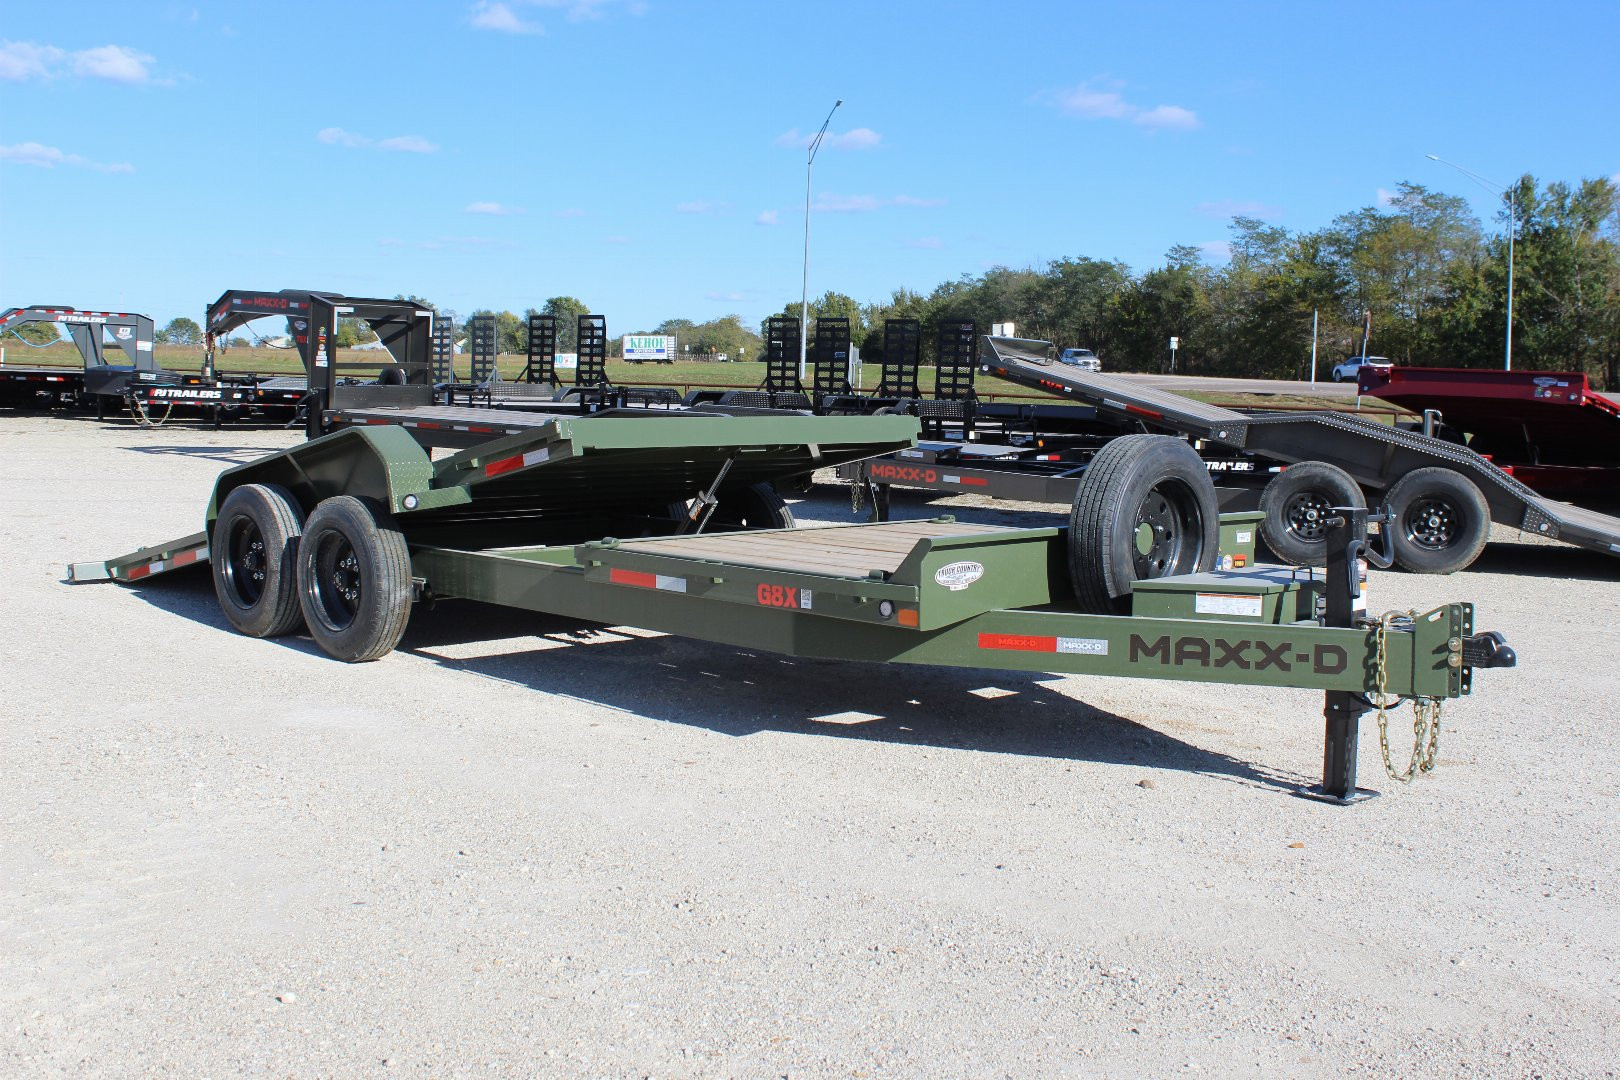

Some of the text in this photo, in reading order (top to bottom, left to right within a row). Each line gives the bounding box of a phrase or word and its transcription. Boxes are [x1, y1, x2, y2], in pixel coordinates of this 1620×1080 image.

[630, 337, 665, 348] KEHOE
[168, 389, 221, 398] TRAILERS
[871, 464, 937, 483] MAXX-D
[757, 583, 798, 608] G8X
[998, 638, 1102, 651] MAXX-D MAXX-D
[1129, 633, 1348, 675] MAXX-D
